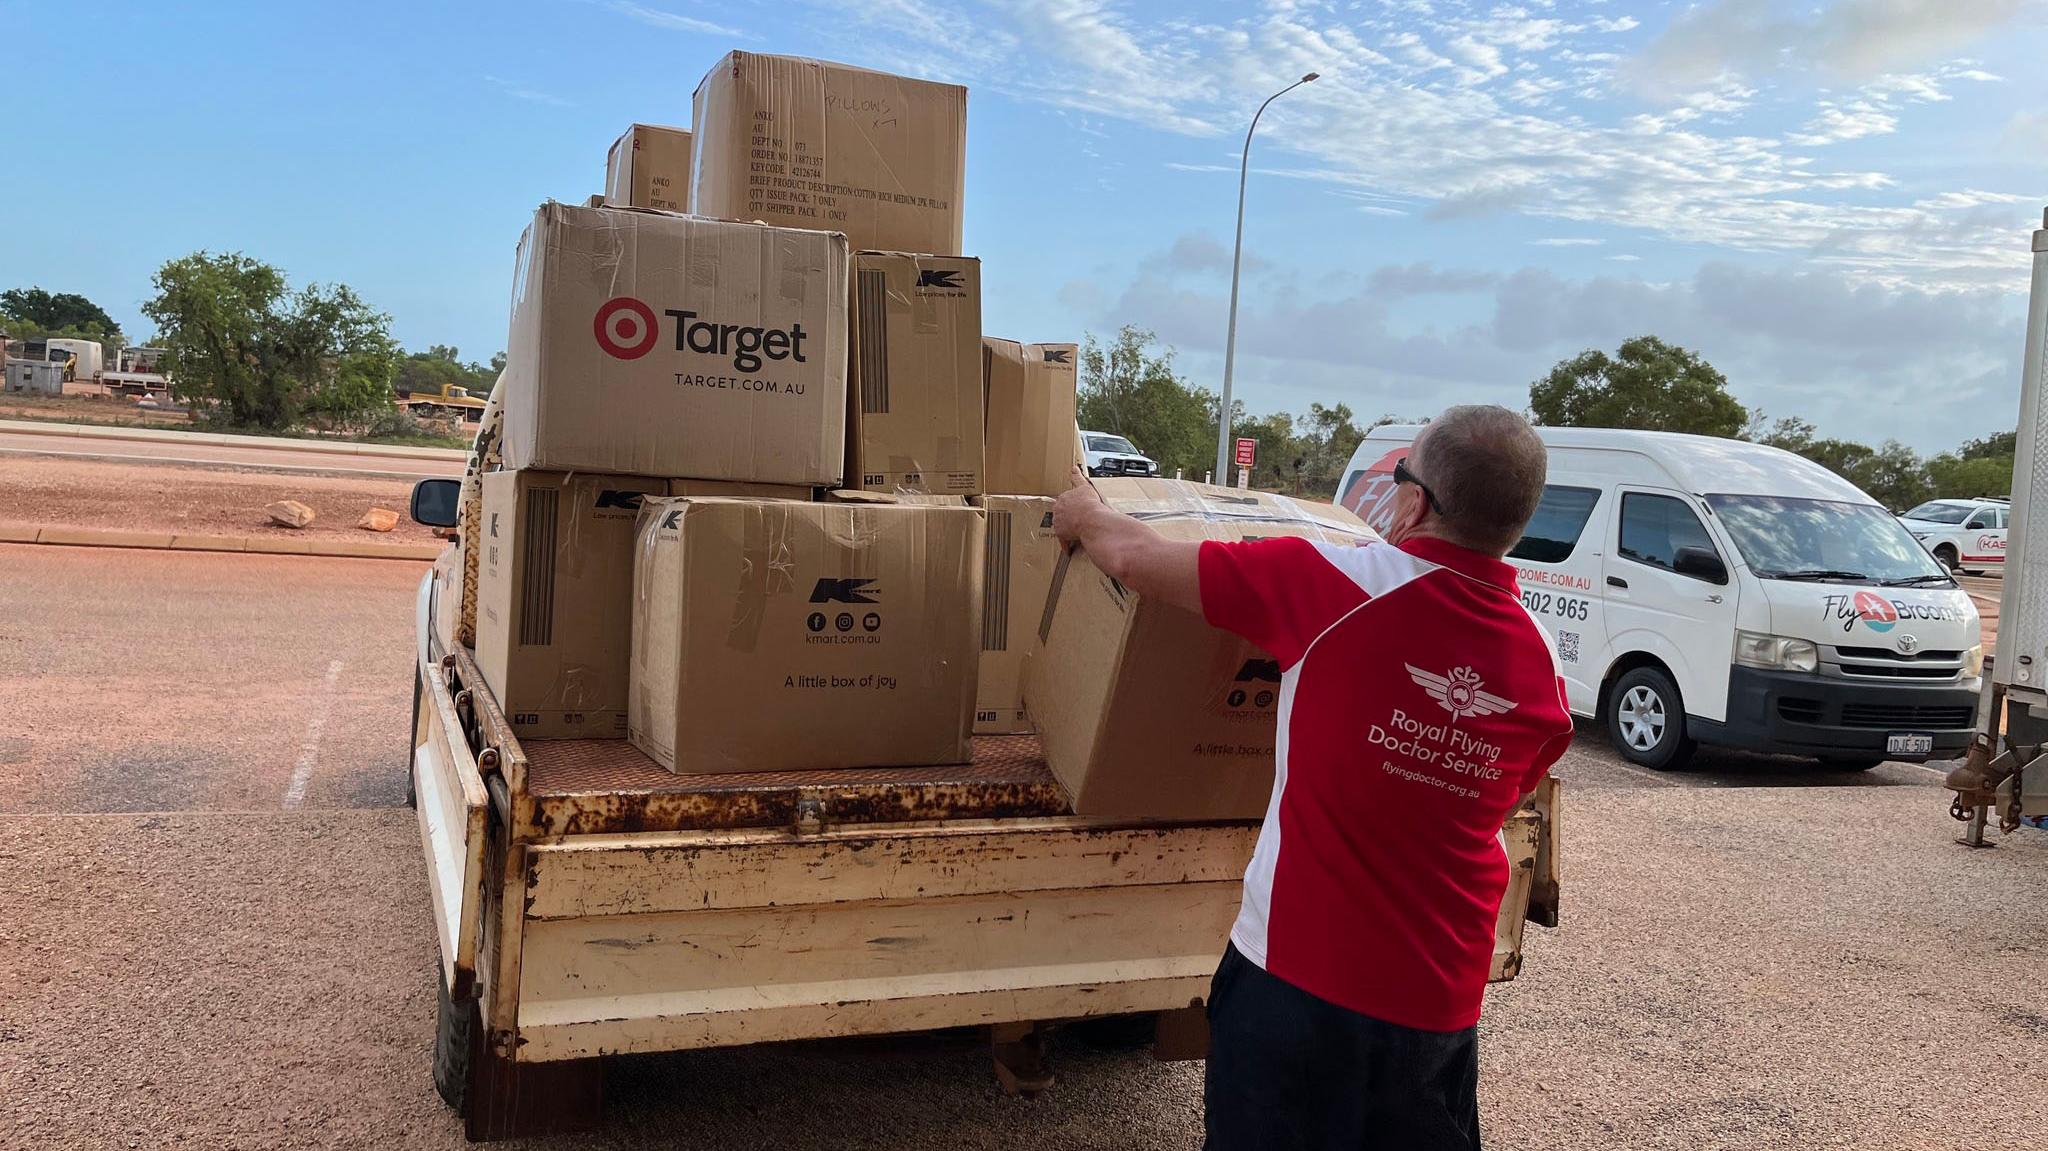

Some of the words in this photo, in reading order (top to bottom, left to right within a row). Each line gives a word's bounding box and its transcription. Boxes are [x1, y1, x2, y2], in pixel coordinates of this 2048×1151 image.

[753, 124, 763, 133] AU
[752, 136, 769, 148] DEPT
[751, 149, 775, 161] ORDER
[652, 176, 670, 187] ANKO
[750, 175, 771, 186] BRIEF
[773, 178, 806, 189] PRODUCT
[651, 188, 660, 197] AU
[749, 188, 764, 200] QTY
[767, 190, 787, 201] ISSUE
[818, 196, 837, 207] ONLY
[651, 199, 667, 210] DEPT
[749, 202, 764, 213] QTY
[766, 202, 795, 215] SHIPPER
[829, 210, 848, 221] ONLY
[665, 309, 807, 373] Target
[674, 373, 805, 395] TARGET.COM.AU
[1516, 567, 1591, 590] ROOME.COM.AU
[1522, 590, 1551, 614] 502
[1556, 596, 1589, 621] 965
[1823, 594, 1866, 632] Fly
[806, 634, 881, 644] kmart.com.au
[784, 675, 794, 688] A
[799, 675, 827, 688] little
[831, 675, 856, 688] box
[860, 675, 875, 687] of
[1390, 709, 1448, 743] Royal
[1450, 729, 1501, 763] Flying
[1206, 743, 1234, 755] little
[1238, 743, 1262, 755] box
[1367, 724, 1441, 764] Doctor
[1442, 751, 1503, 781] Service
[1382, 761, 1481, 799] flyingdoctor.org.au
